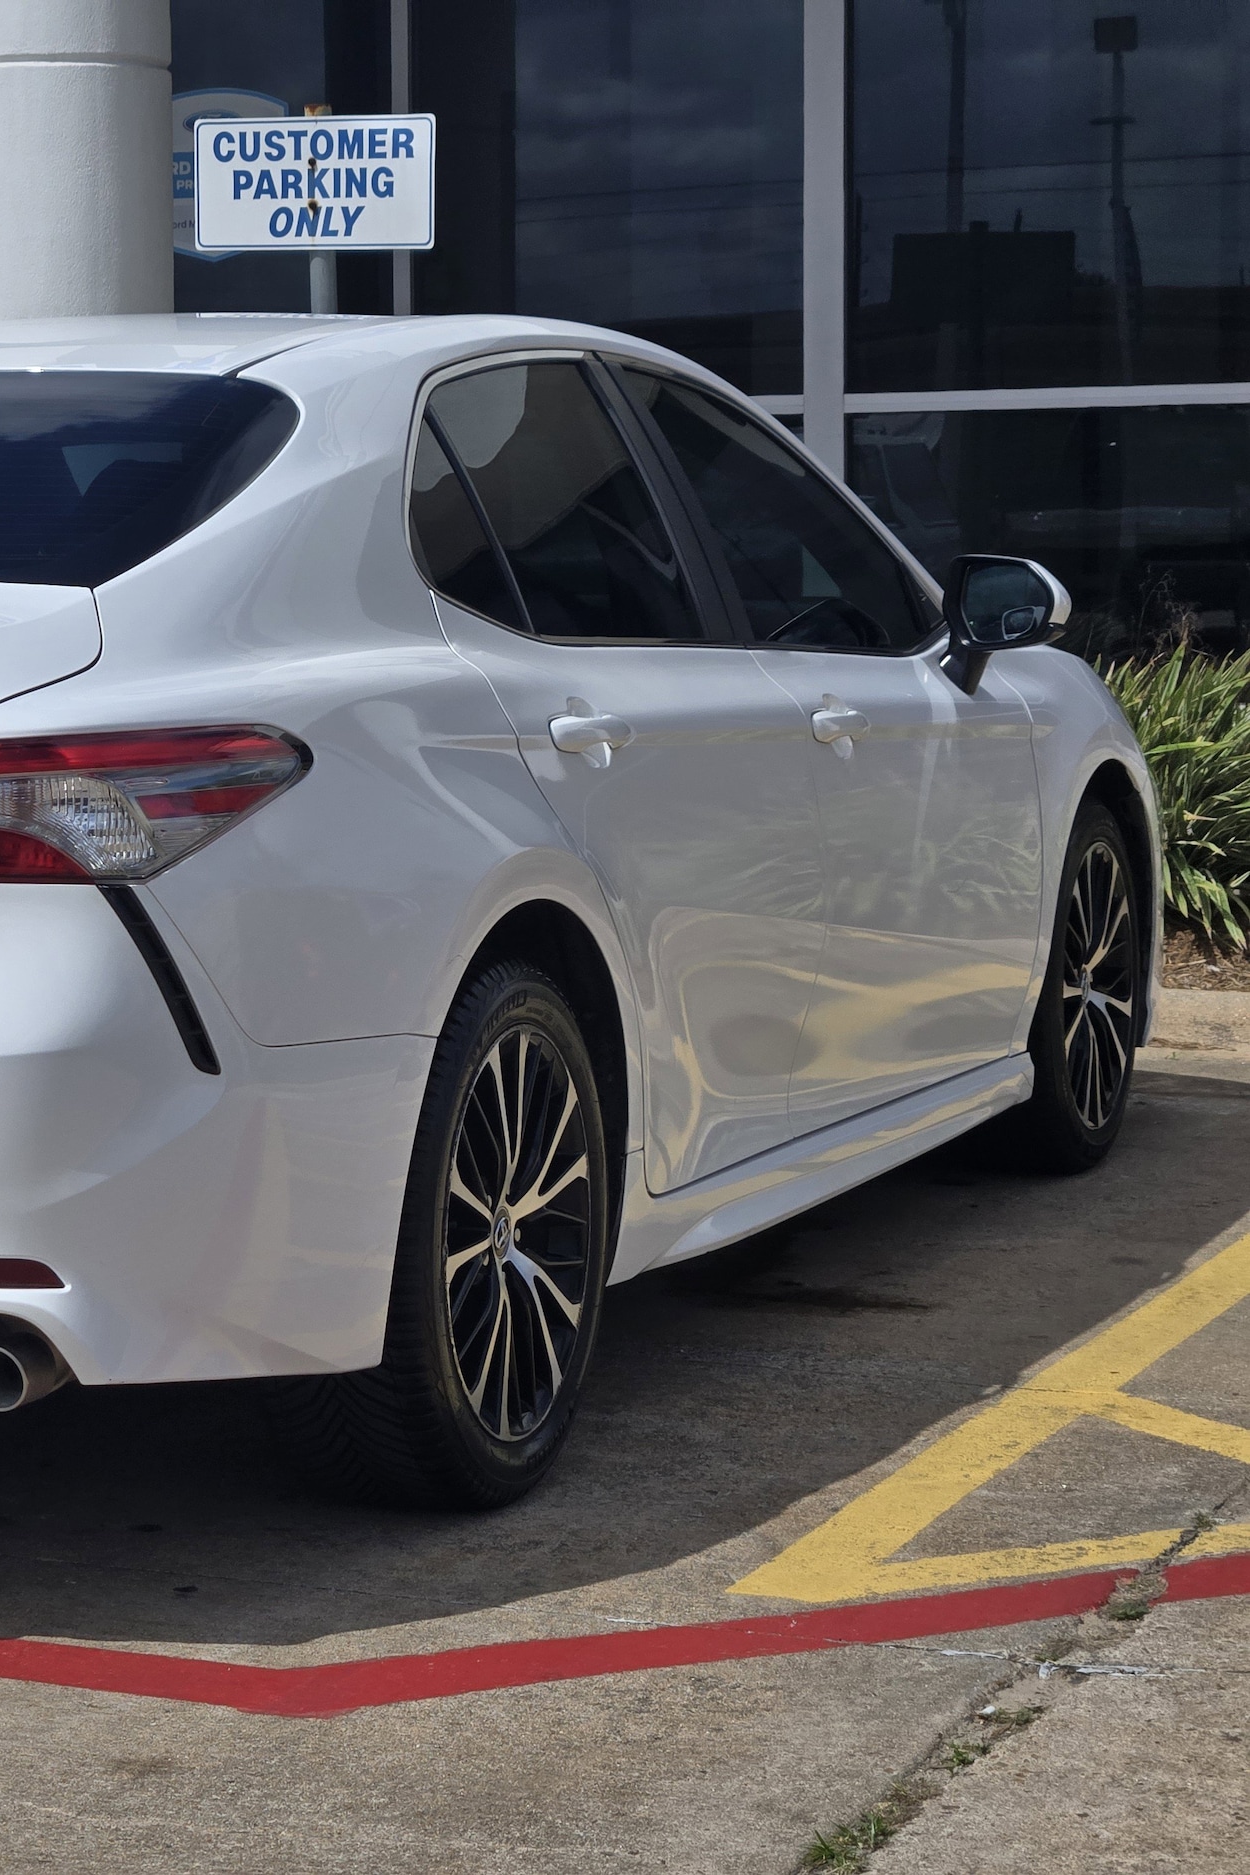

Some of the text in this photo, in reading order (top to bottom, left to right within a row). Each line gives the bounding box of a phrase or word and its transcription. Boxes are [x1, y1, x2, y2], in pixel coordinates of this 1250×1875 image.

[213, 128, 415, 163] CUSTOMER
[232, 166, 394, 200] PARKING
[269, 205, 365, 237] ONLY
